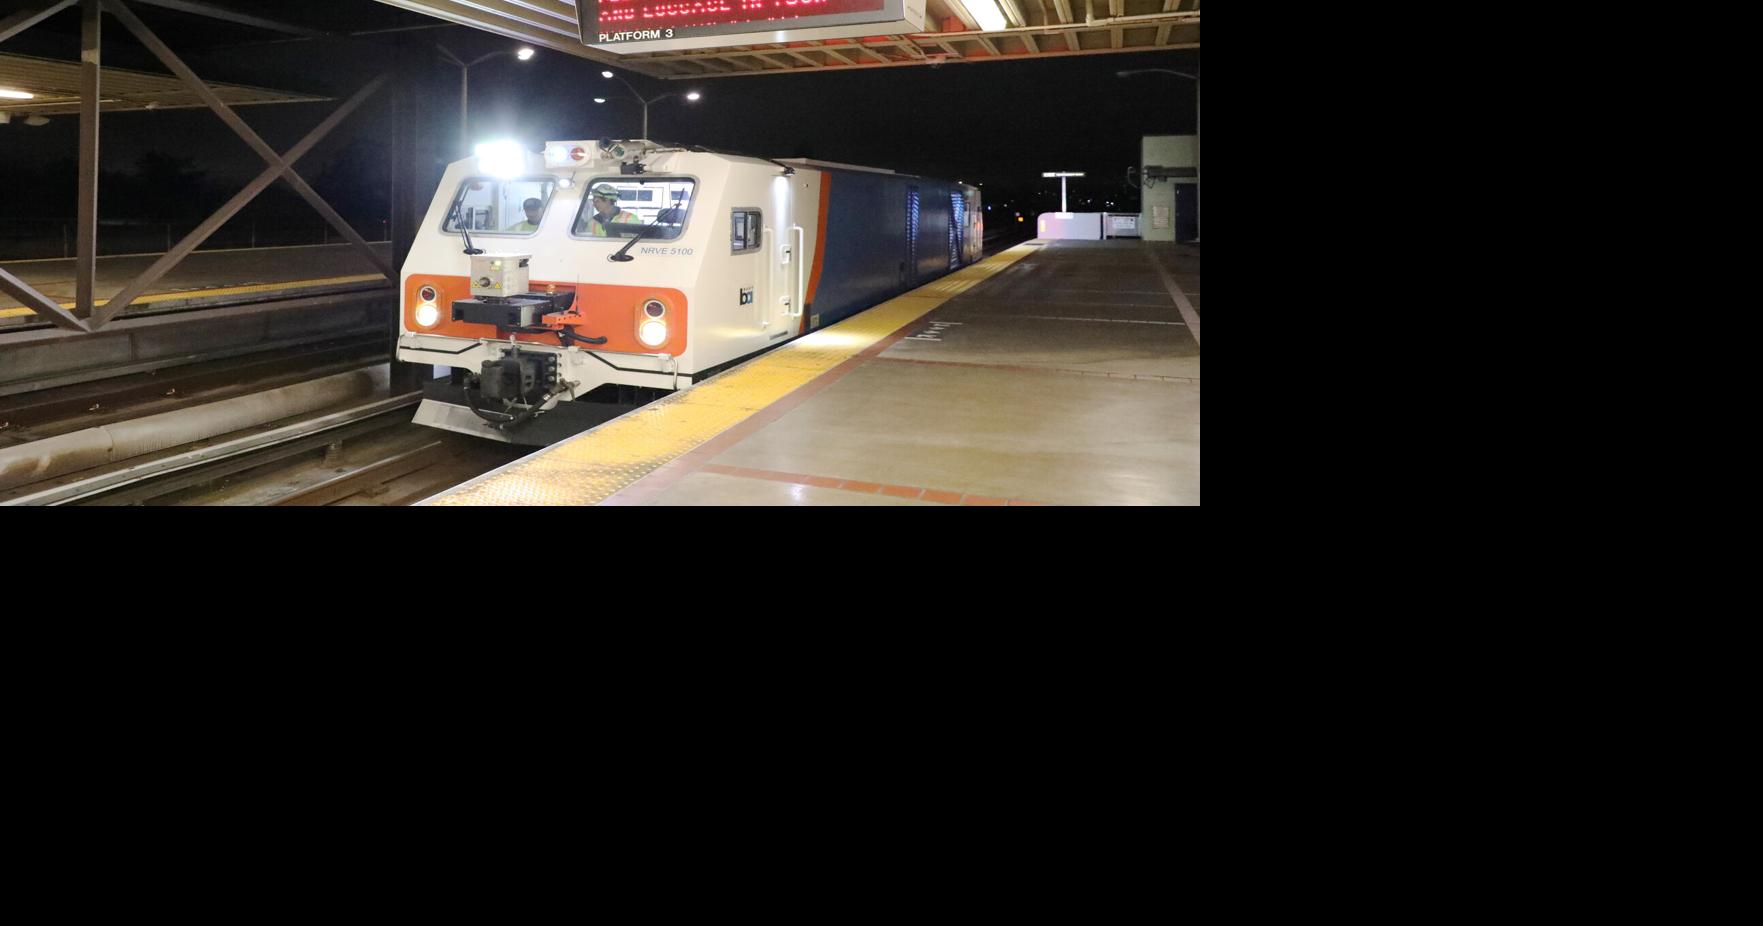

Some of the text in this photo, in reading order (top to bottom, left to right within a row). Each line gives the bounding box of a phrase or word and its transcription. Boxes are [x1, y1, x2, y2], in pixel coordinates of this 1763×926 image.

[598, 28, 674, 43] PLATFORM 3
[670, 248, 694, 256] 5100
